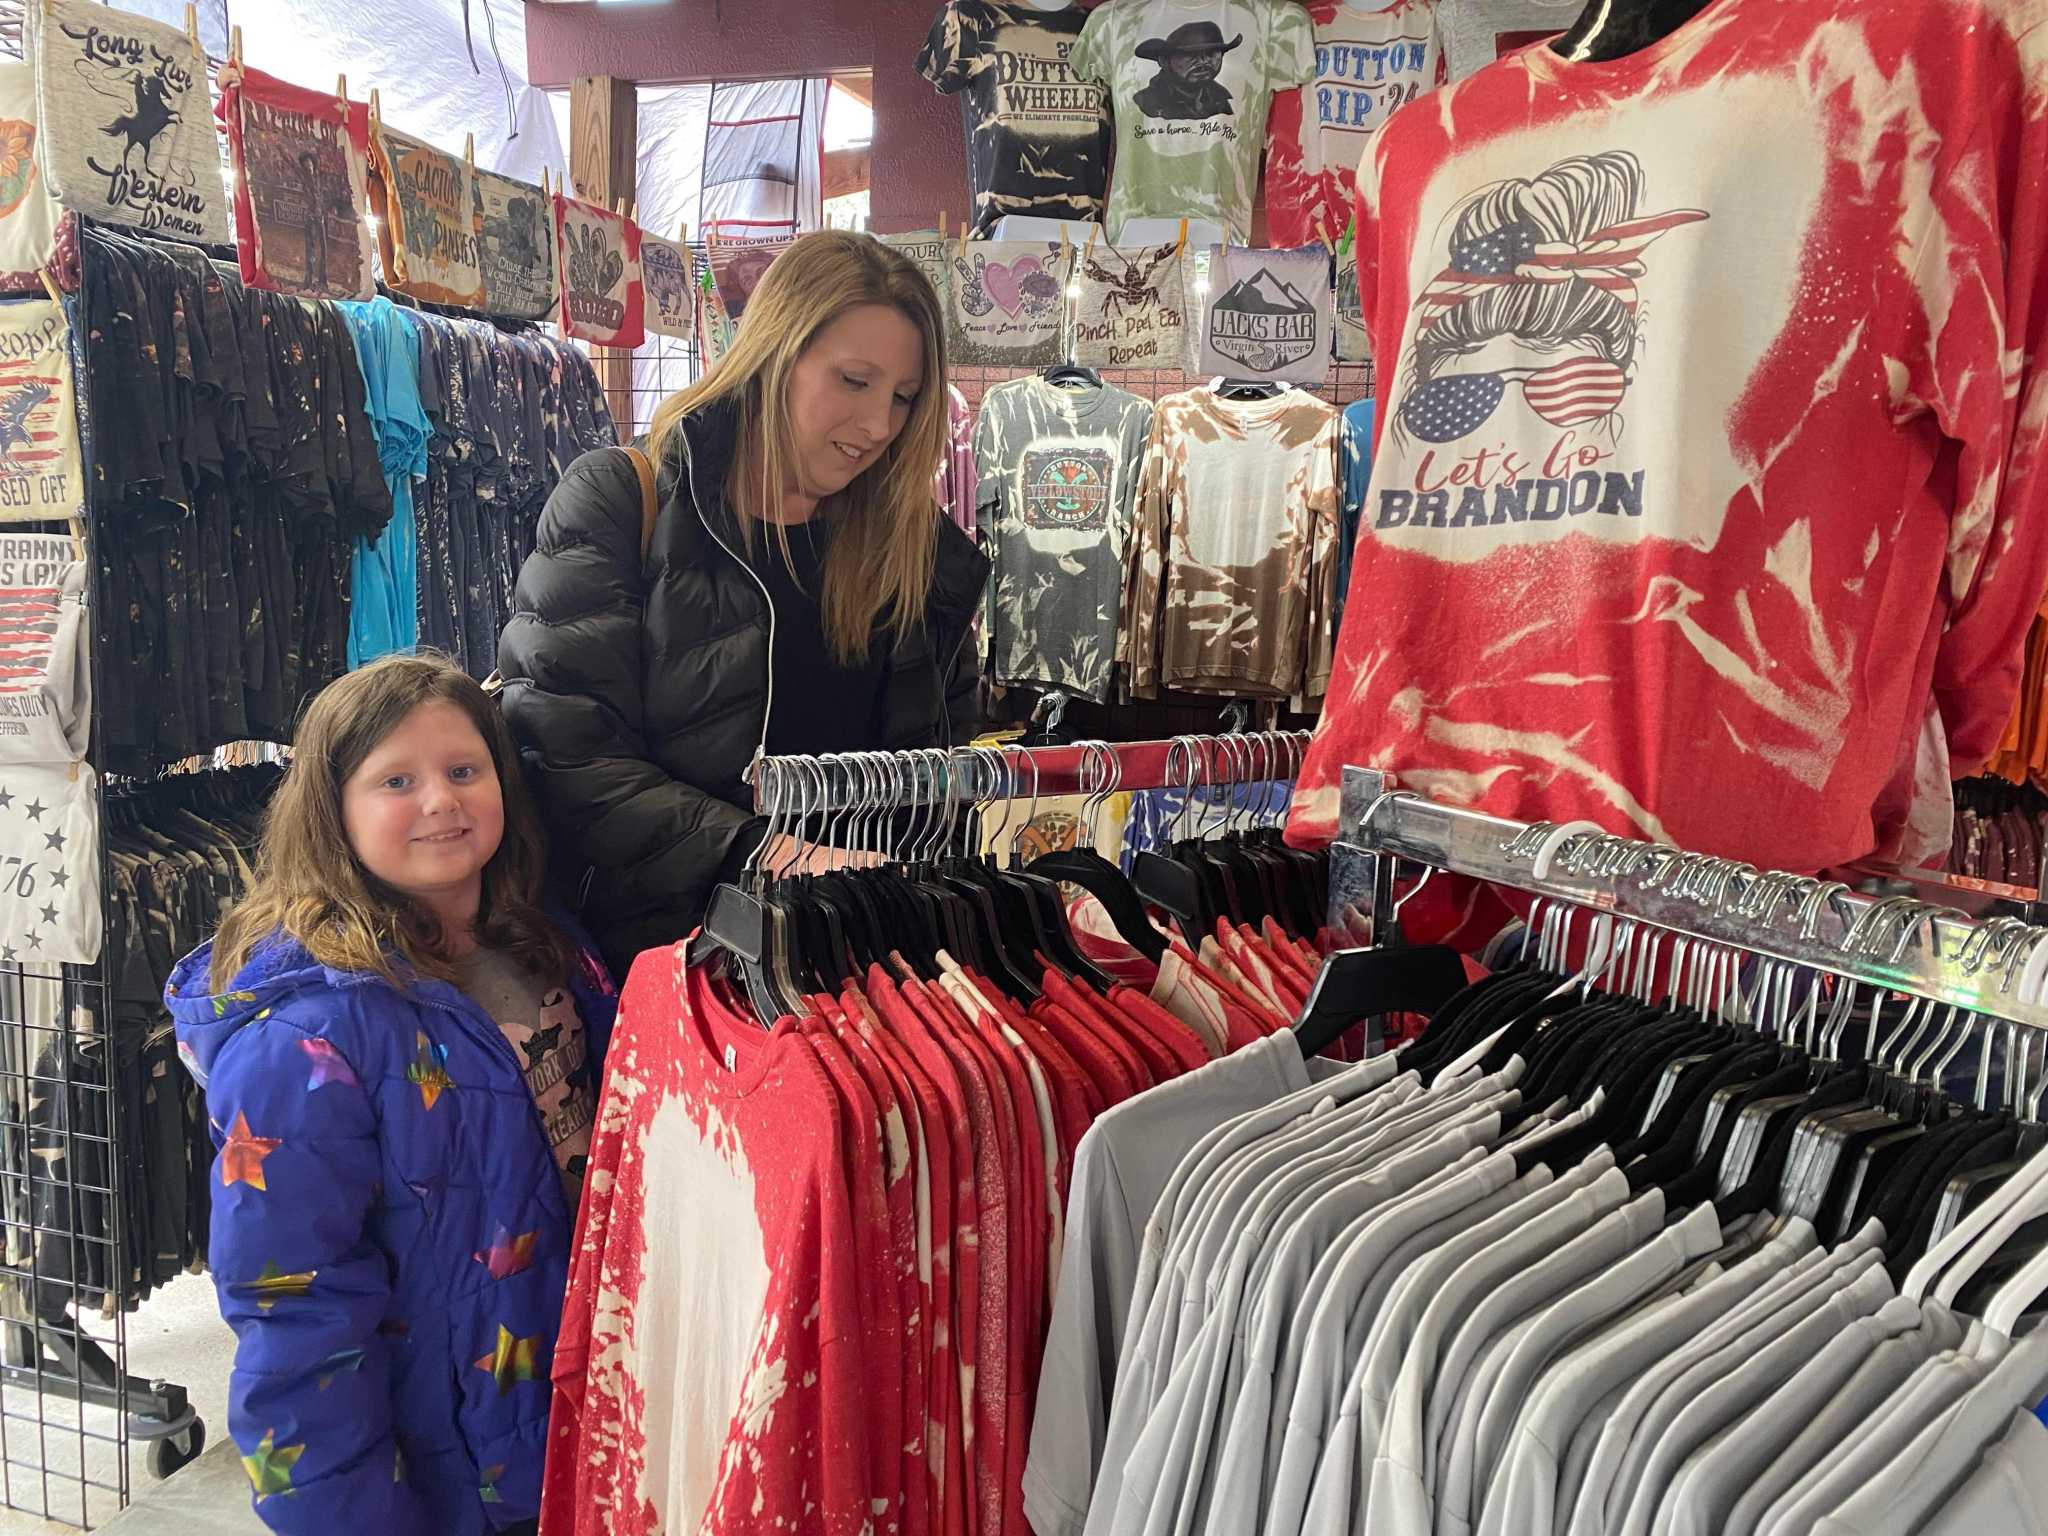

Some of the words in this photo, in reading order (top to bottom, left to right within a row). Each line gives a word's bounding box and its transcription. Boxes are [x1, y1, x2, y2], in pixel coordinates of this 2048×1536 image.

[59, 25, 144, 66] Long
[150, 44, 193, 94] Live
[1315, 42, 1427, 81] DUTTON
[1025, 113, 1060, 121] ELIMINATE
[1317, 88, 1373, 126] RIP
[1134, 124, 1157, 139] Save
[1199, 121, 1221, 136] Ride
[1222, 123, 1237, 141] Rip
[87, 157, 206, 214] Western
[125, 198, 205, 236] Women
[735, 236, 774, 247] GROWN
[775, 235, 795, 243] UPS
[900, 244, 937, 259] OUR
[960, 322, 986, 334] Peace
[996, 322, 1018, 335] Love
[1213, 311, 1268, 339] JACKS
[1276, 314, 1313, 338] BAR
[1109, 338, 1158, 365] Repeat
[1223, 339, 1255, 353] Virgin
[1275, 343, 1305, 354] River
[1414, 442, 1530, 492] Let's
[1542, 430, 1615, 479] Go
[40, 473, 67, 504] OFF
[1375, 469, 1645, 529] BRANDON
[1050, 508, 1085, 521] RANCH
[0, 539, 77, 561] RANNY
[0, 562, 15, 586] S
[22, 562, 73, 586] LAW
[20, 694, 49, 717] DUTY
[0, 855, 39, 898] 76
